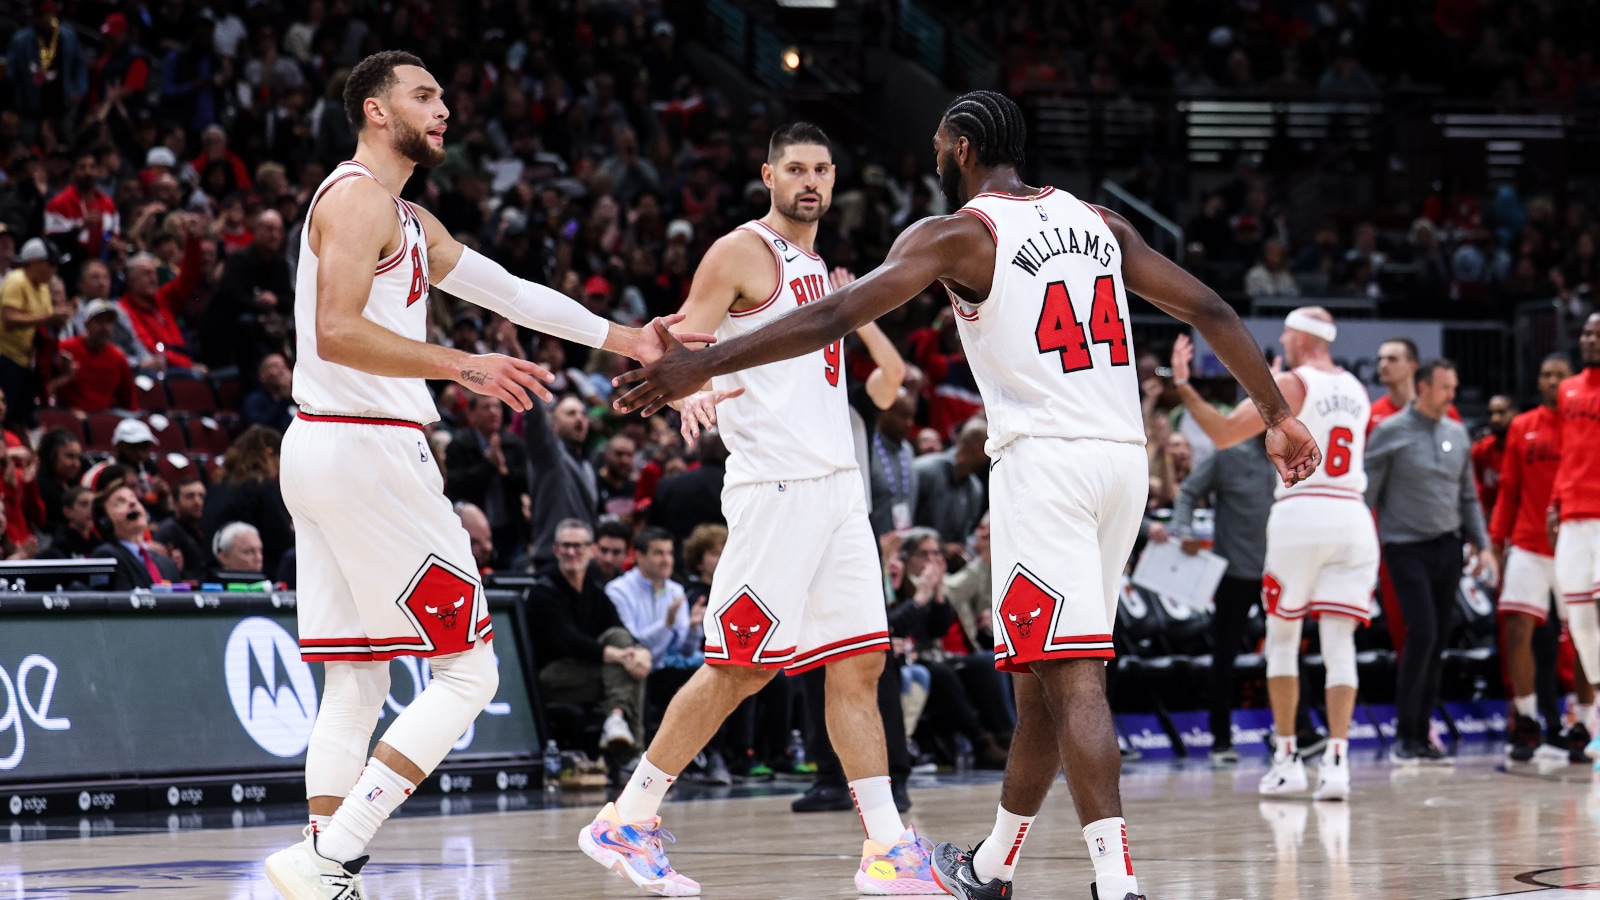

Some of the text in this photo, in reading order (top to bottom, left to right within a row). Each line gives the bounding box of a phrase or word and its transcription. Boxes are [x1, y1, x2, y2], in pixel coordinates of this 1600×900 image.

[1011, 227, 1115, 277] WILLIAMS
[1035, 274, 1130, 374] 44
[460, 369, 494, 386] Saint
[1324, 426, 1353, 477] 6
